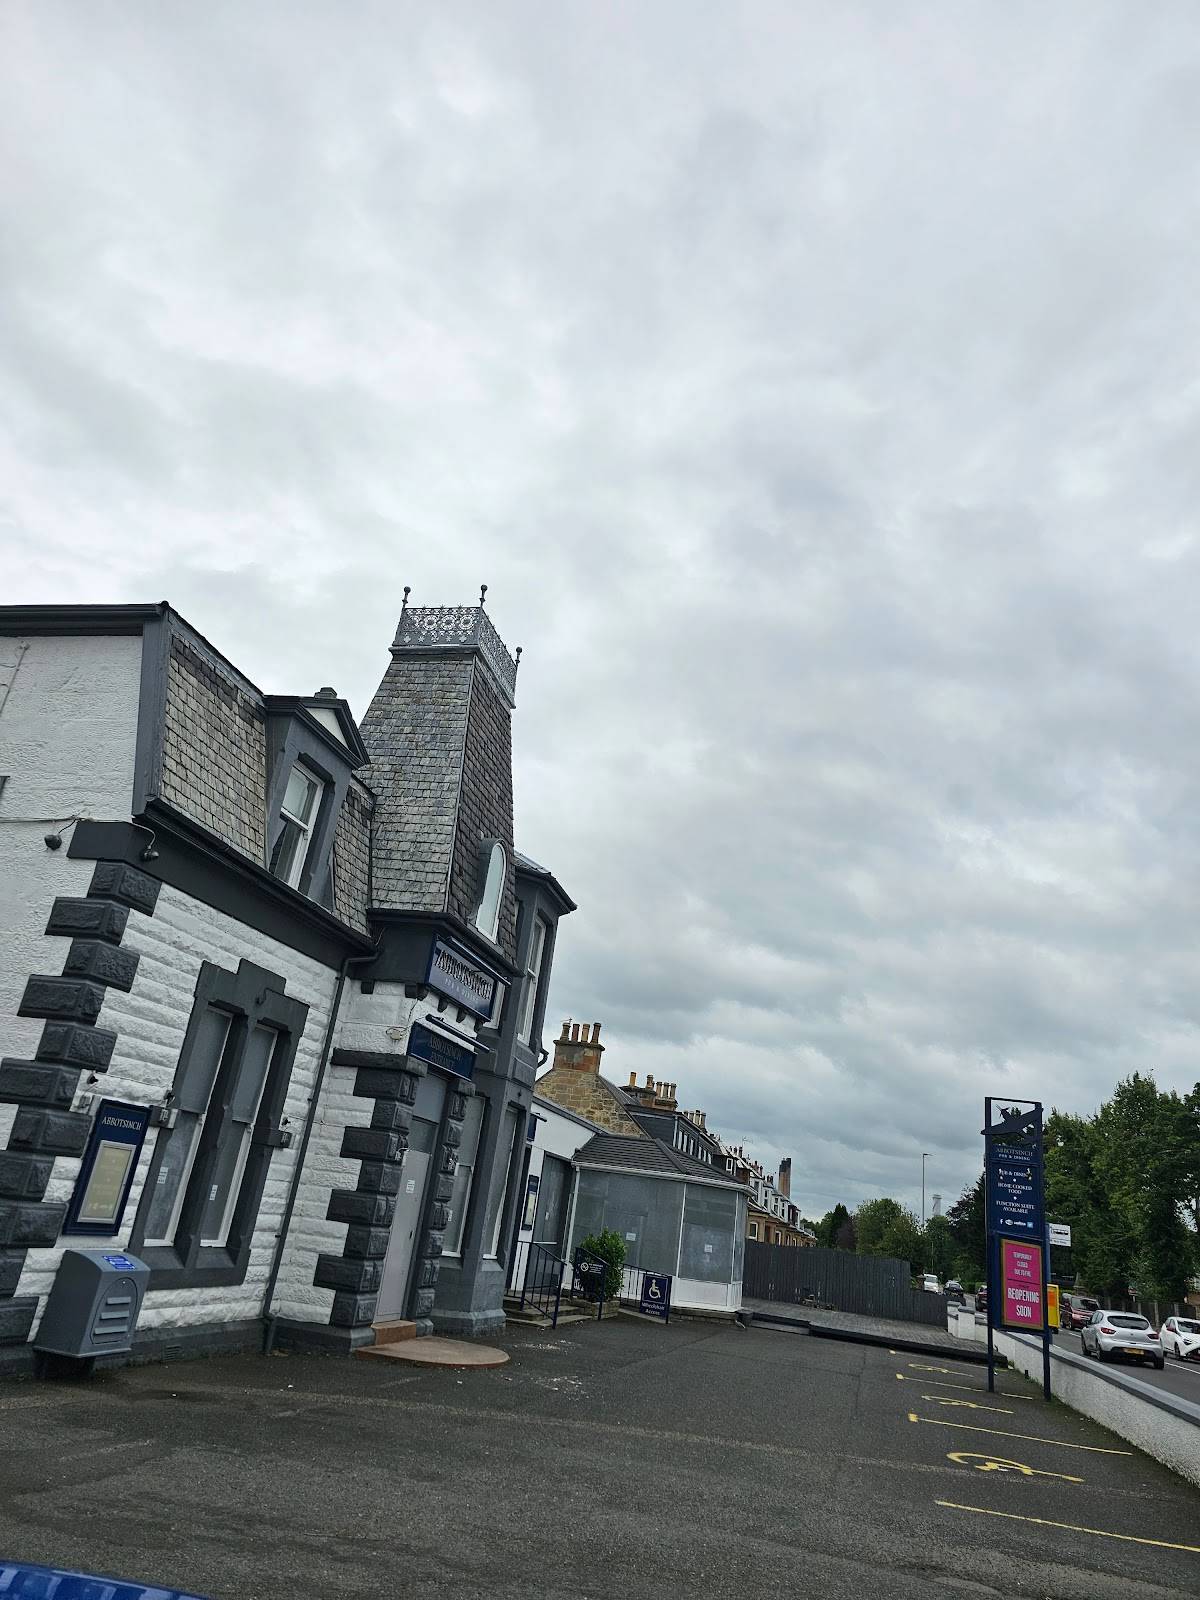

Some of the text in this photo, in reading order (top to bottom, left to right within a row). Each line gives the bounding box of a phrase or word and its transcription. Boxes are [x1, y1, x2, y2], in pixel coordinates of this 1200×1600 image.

[101, 1116, 142, 1131] ABBOTSINCH
[997, 1182, 1033, 1191] HOME COOKED
[996, 1200, 1035, 1210] FUNCTION SUITE
[1003, 1206, 1029, 1214] AVAILABLE
[1007, 1287, 1040, 1304] REOPENING
[1015, 1304, 1032, 1318] SOON
